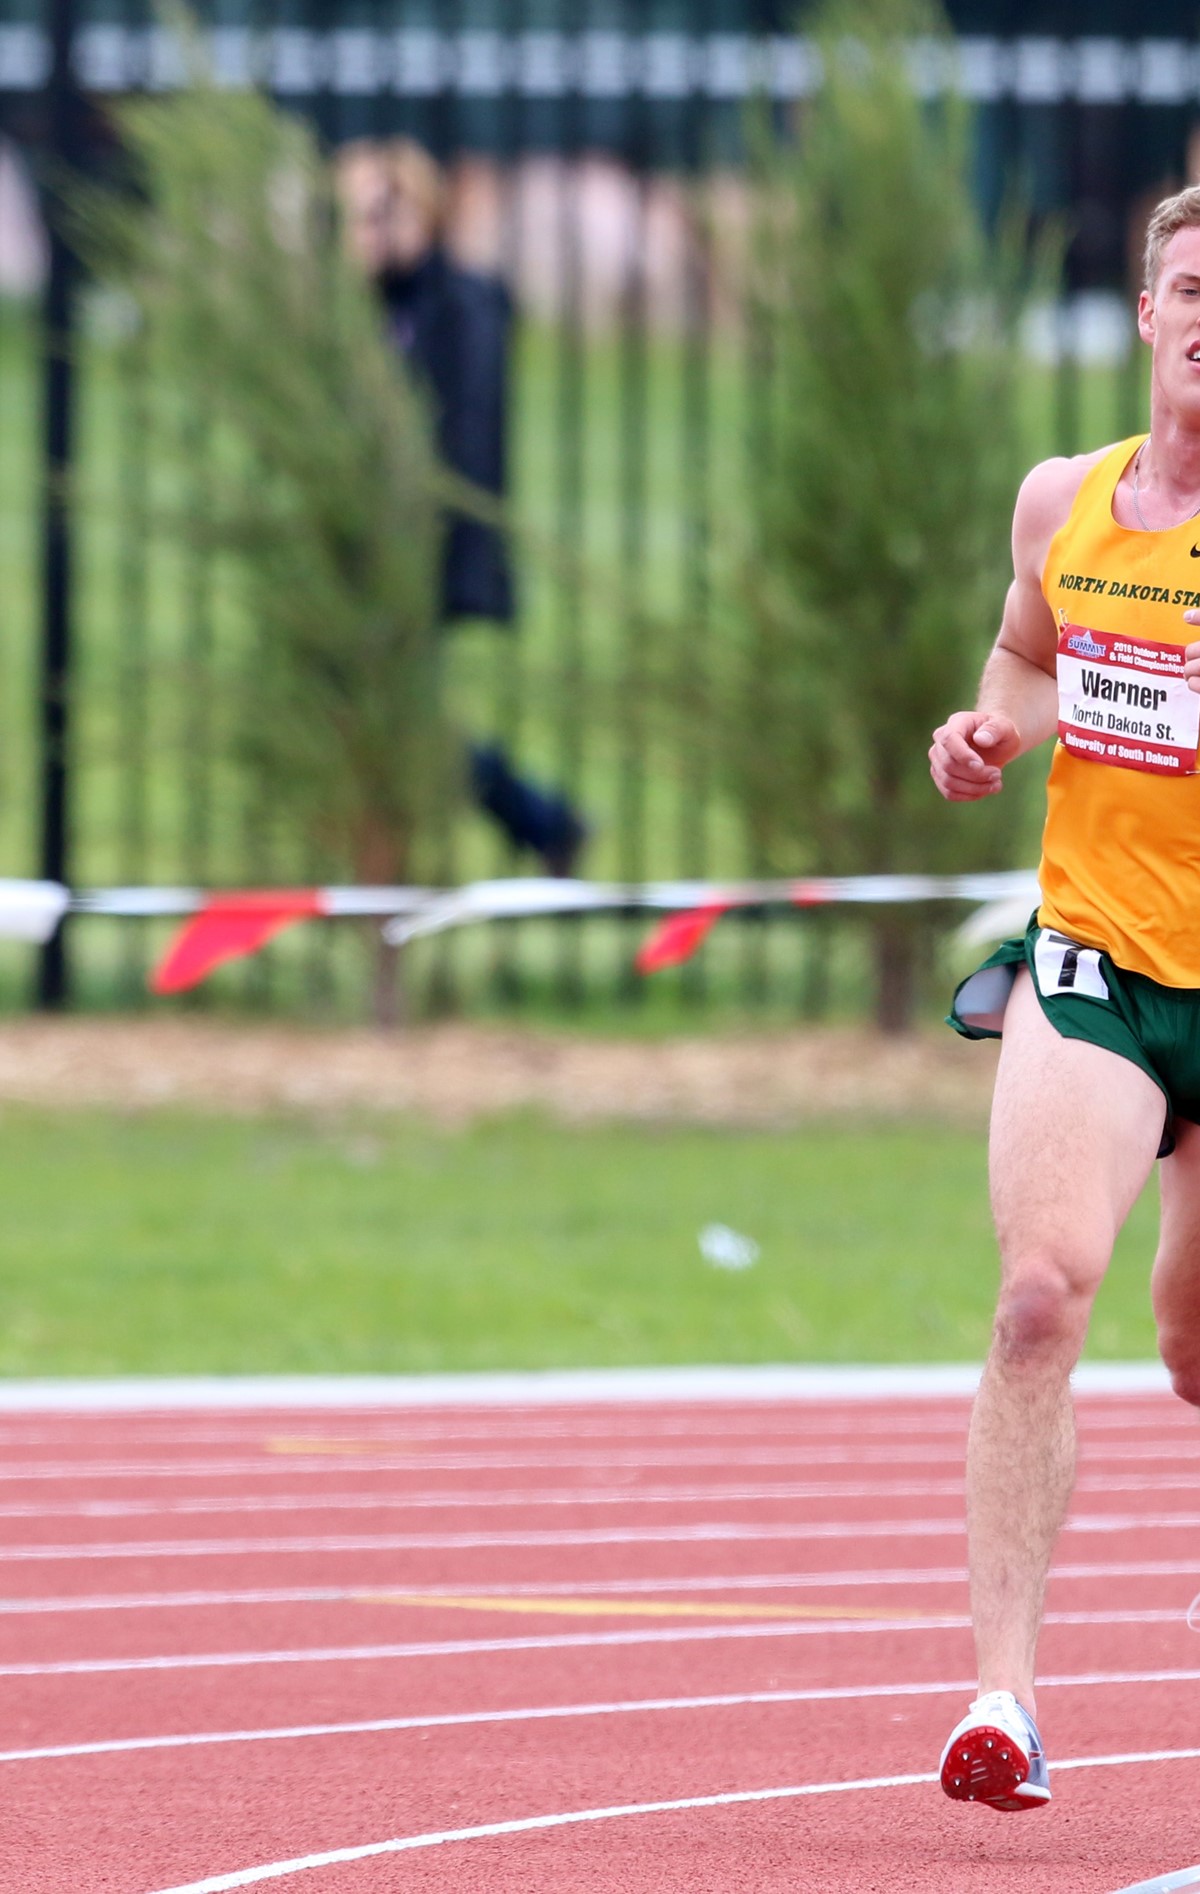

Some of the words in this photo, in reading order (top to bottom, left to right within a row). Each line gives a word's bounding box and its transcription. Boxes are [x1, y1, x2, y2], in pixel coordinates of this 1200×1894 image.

[1058, 574, 1107, 594] NORTH
[1108, 581, 1170, 603] DAKOTA
[1068, 639, 1106, 656] SUMMIT
[1133, 646, 1158, 659] Outdoor
[1160, 651, 1181, 663] Track
[1109, 652, 1116, 661] &
[1117, 653, 1133, 664] Field
[1134, 657, 1184, 674] Championships
[1081, 668, 1167, 711] Warner
[1072, 704, 1104, 727] North
[1107, 713, 1152, 737] Dakota
[1156, 723, 1175, 741] St.
[1065, 732, 1106, 755] University
[1107, 744, 1117, 756] of
[1118, 747, 1144, 761] South
[1145, 750, 1179, 768] Dakota
